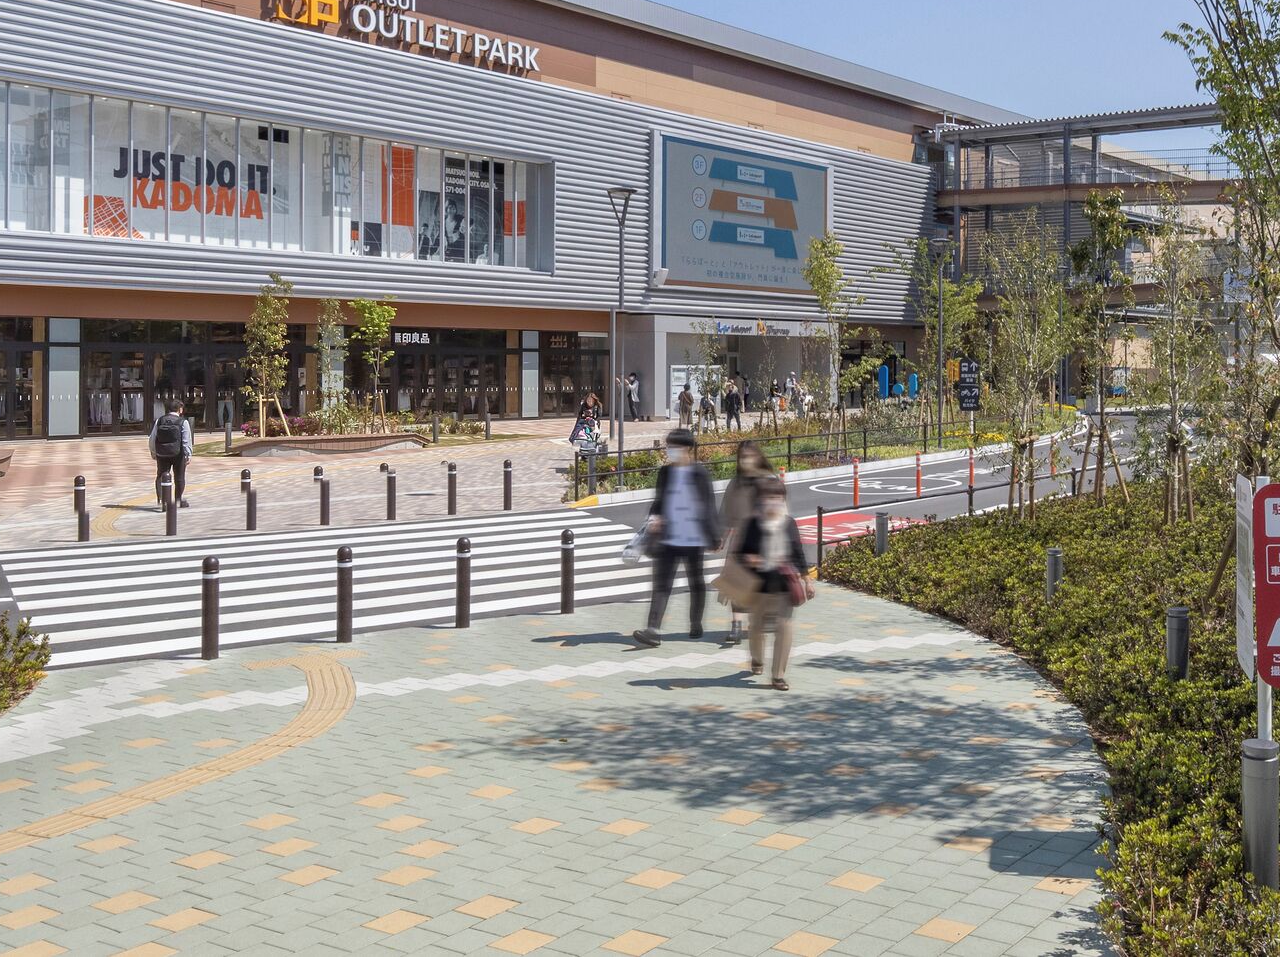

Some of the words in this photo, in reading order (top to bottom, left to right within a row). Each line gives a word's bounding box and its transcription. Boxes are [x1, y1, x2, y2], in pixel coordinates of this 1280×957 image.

[352, 4, 467, 54] OUTLET
[474, 33, 540, 72] PARK
[113, 147, 185, 182] JUST
[195, 157, 236, 191] DO
[247, 164, 276, 196] IT.
[132, 178, 264, 220] KADOMA
[694, 192, 704, 203] 2F
[694, 225, 704, 236] 1F
[394, 332, 430, 344] 無印良品
